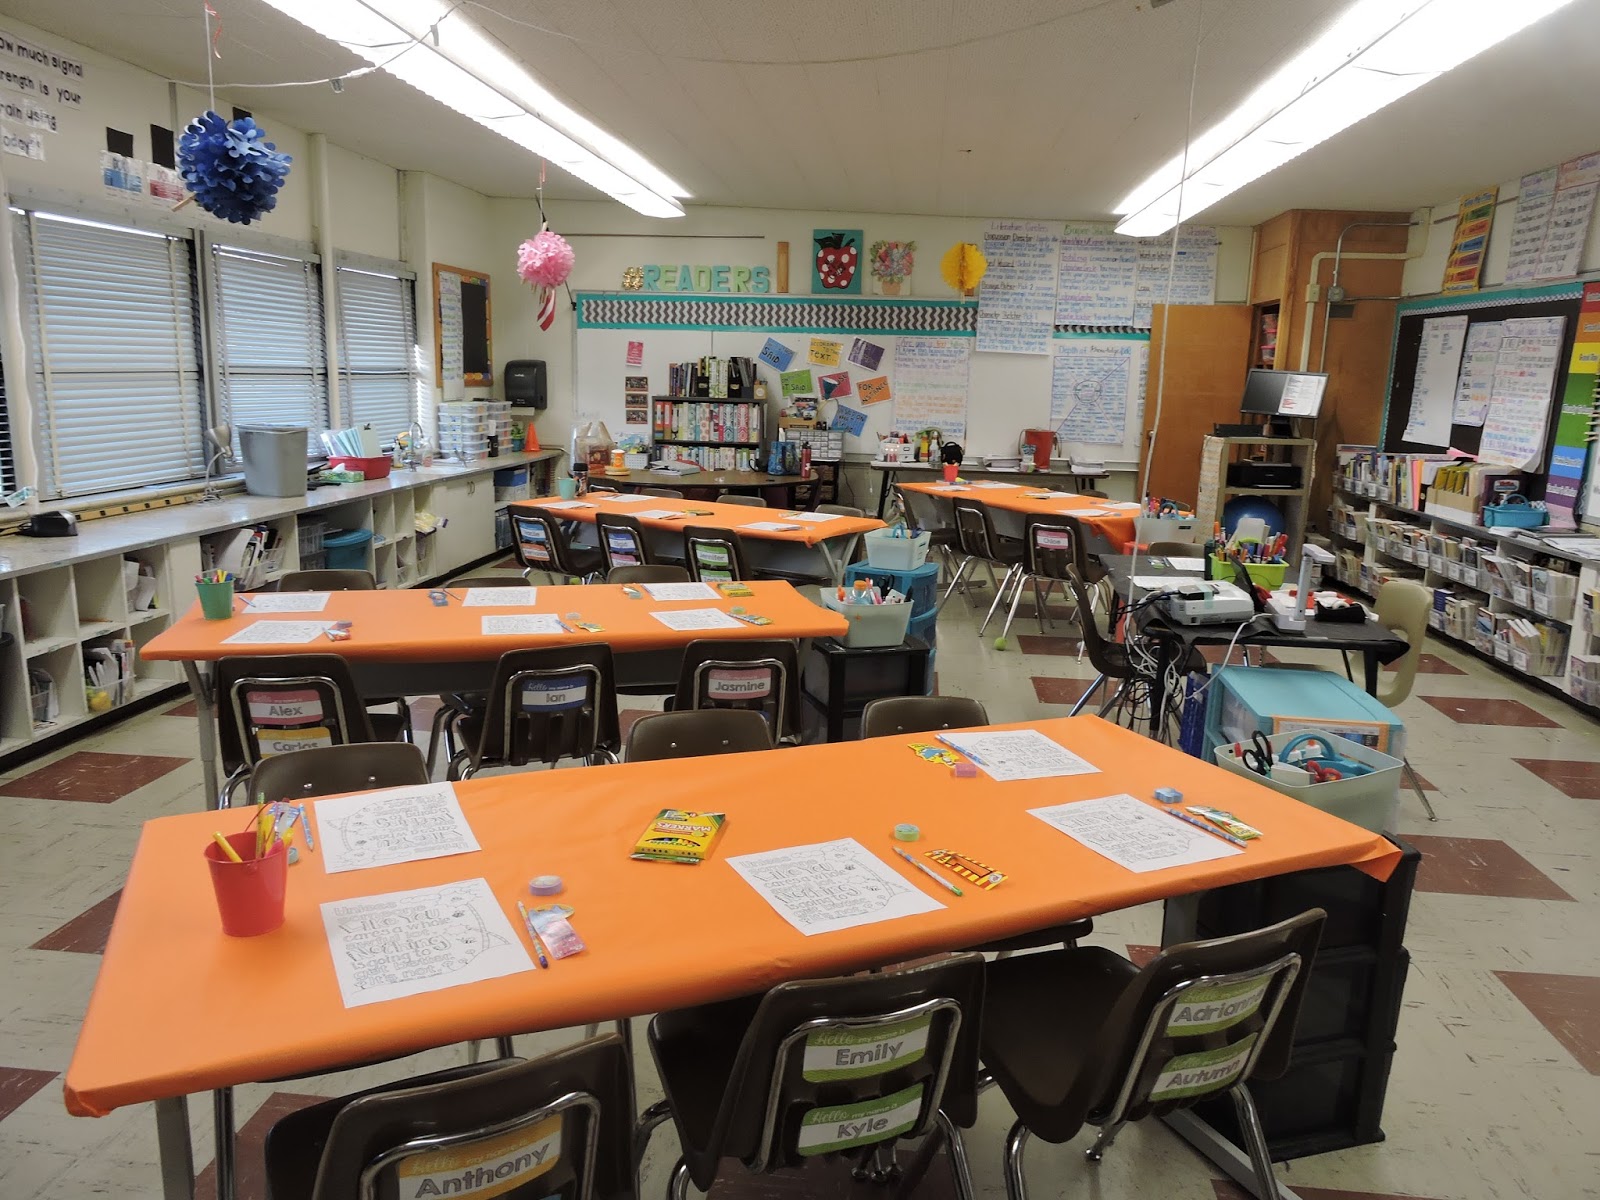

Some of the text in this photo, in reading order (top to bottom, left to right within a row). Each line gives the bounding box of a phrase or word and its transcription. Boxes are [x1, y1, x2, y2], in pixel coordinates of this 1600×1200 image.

[17, 45, 49, 66] much
[52, 56, 83, 77] signal
[39, 80, 49, 96] is
[56, 87, 81, 104] your
[762, 347, 779, 363] SAID
[715, 681, 765, 692] Jasmine
[546, 693, 566, 703] Ian
[269, 705, 303, 716] Alex
[656, 822, 712, 832] MARKERS
[334, 901, 398, 917] Unless
[338, 916, 398, 934] Like
[343, 928, 391, 942] cares
[407, 917, 451, 931] whole
[346, 935, 451, 962] Nothing
[351, 947, 431, 971] is going to
[353, 963, 390, 980] get
[836, 1041, 903, 1066] Emily
[1166, 1059, 1241, 1088] Autumn
[837, 1117, 889, 1139] Kyle
[415, 1143, 550, 1199] Anthony
